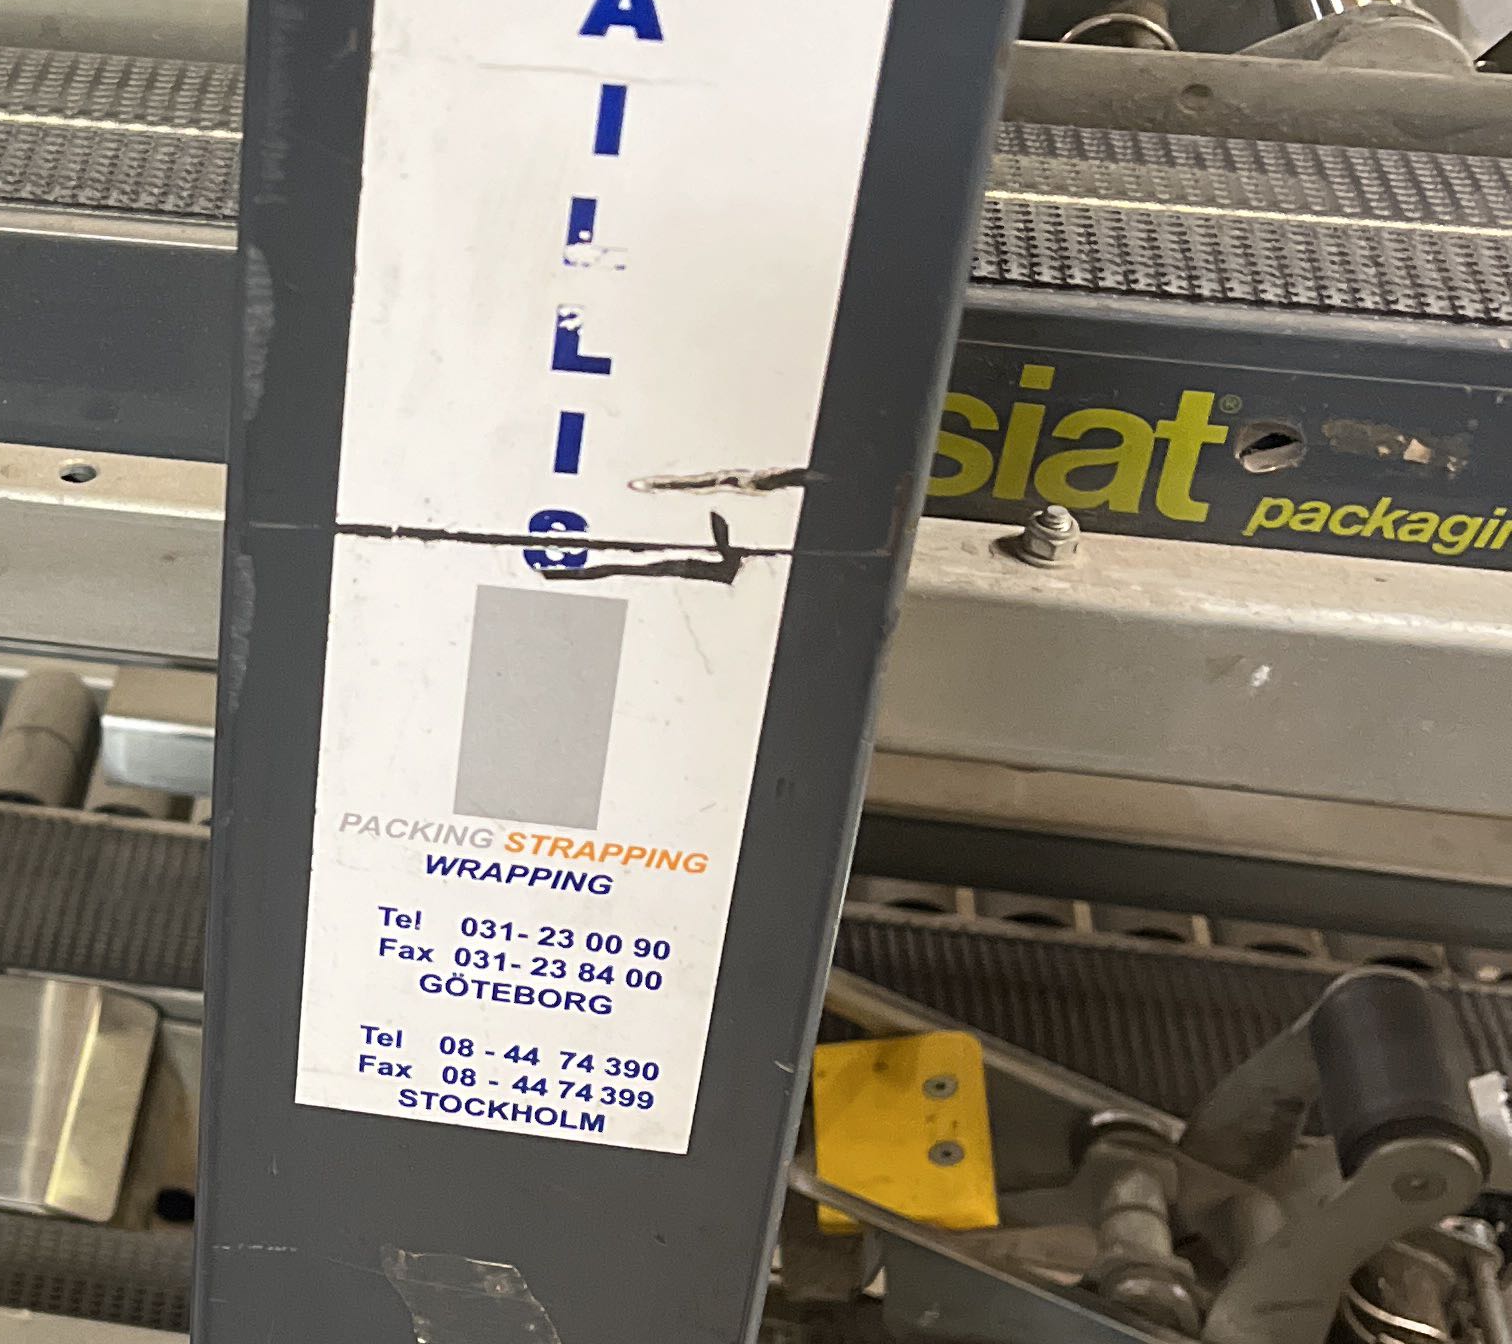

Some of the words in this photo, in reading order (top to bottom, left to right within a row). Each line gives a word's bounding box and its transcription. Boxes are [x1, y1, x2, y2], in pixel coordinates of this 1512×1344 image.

[338, 812, 494, 849] PACKING
[503, 831, 710, 875] STRAPPING
[424, 854, 615, 896] WRAPPING
[378, 905, 422, 930] Tel
[538, 926, 575, 949] 23
[585, 932, 623, 955] 00
[634, 937, 671, 961] 90
[379, 937, 435, 962] Fax
[530, 957, 567, 979] 23
[578, 962, 614, 985] 84
[625, 968, 663, 991] 00
[419, 972, 613, 1016] GÖTEBORG
[360, 1024, 403, 1049] Tel
[439, 1036, 474, 1058] 08
[503, 1044, 540, 1067] 44
[560, 1051, 595, 1074] 74
[604, 1057, 660, 1082] 390
[358, 1054, 413, 1079] Fax
[442, 1065, 476, 1087] 08
[512, 1075, 548, 1097] 44
[559, 1080, 593, 1102] 74
[600, 1086, 654, 1110] 399
[398, 1088, 606, 1133] STOCKHOLM
